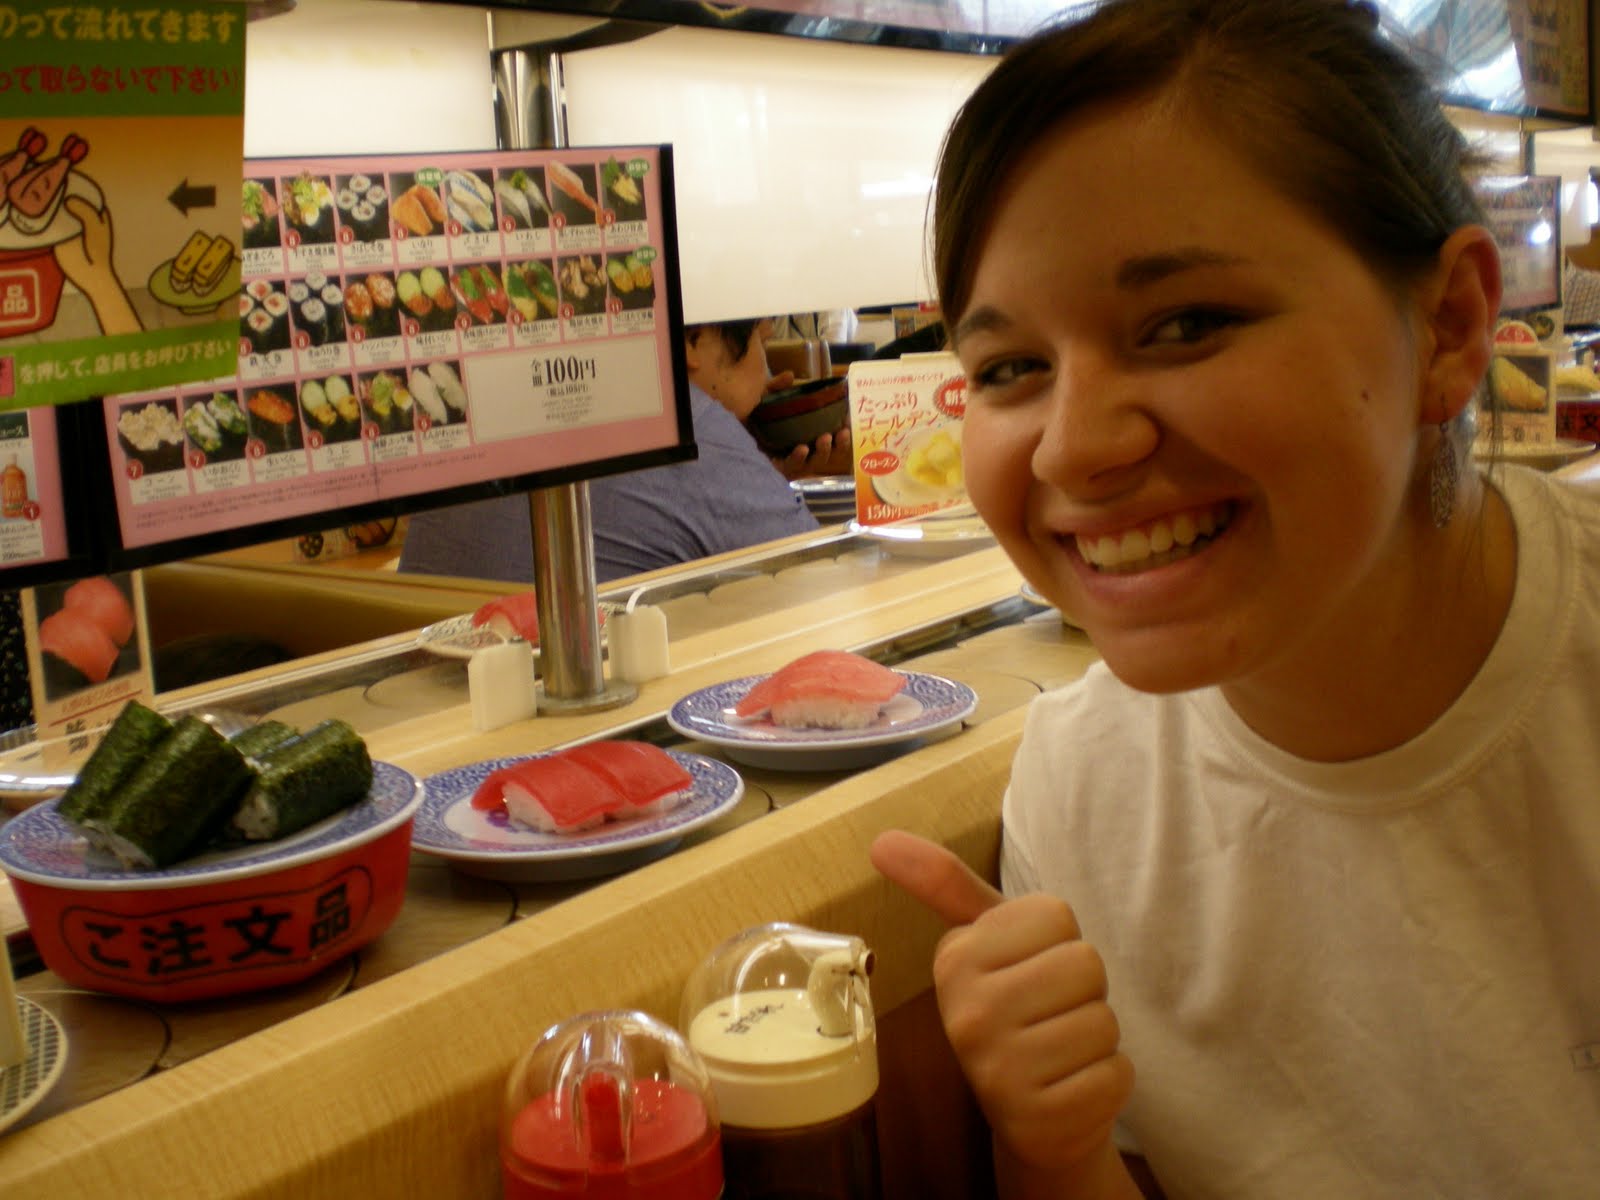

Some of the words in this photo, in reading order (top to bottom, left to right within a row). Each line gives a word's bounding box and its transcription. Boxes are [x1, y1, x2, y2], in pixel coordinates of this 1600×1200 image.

[4, 284, 28, 314] 品
[545, 355, 596, 384] 100円
[859, 409, 939, 432] ゴールデン
[859, 432, 906, 450] パイン
